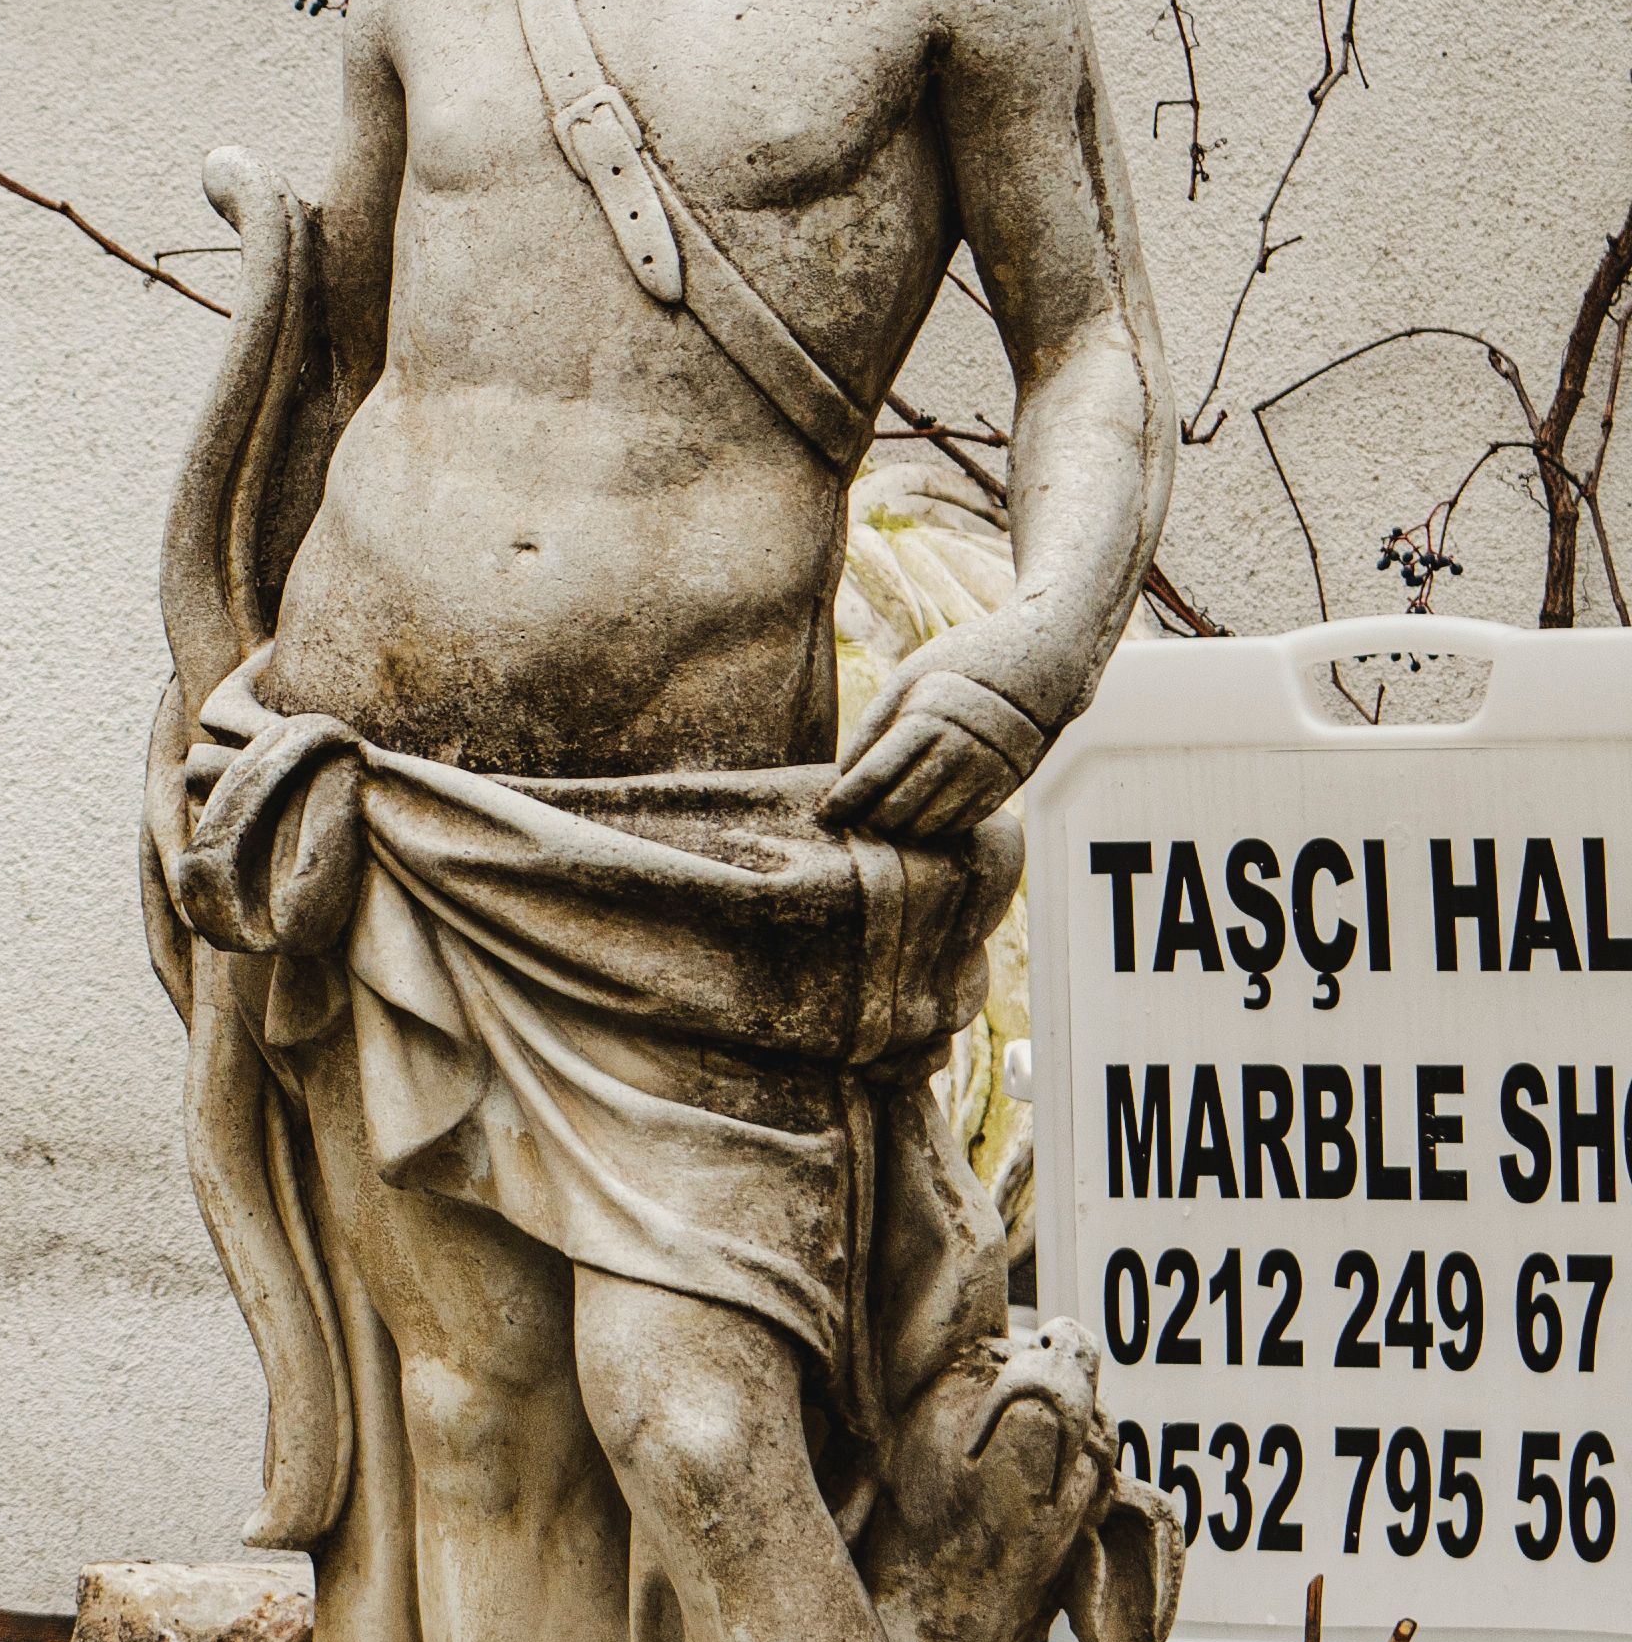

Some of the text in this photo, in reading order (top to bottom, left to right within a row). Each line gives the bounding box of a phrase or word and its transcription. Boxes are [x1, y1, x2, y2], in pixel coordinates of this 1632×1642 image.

[1089, 837, 1632, 1011] TAŞÇI HAL
[1105, 1062, 1632, 1204] MARBLE SH
[1103, 1247, 1613, 1374] 0212 249 67
[1334, 1426, 1484, 1559] 795
[1514, 1430, 1616, 1564] 56
